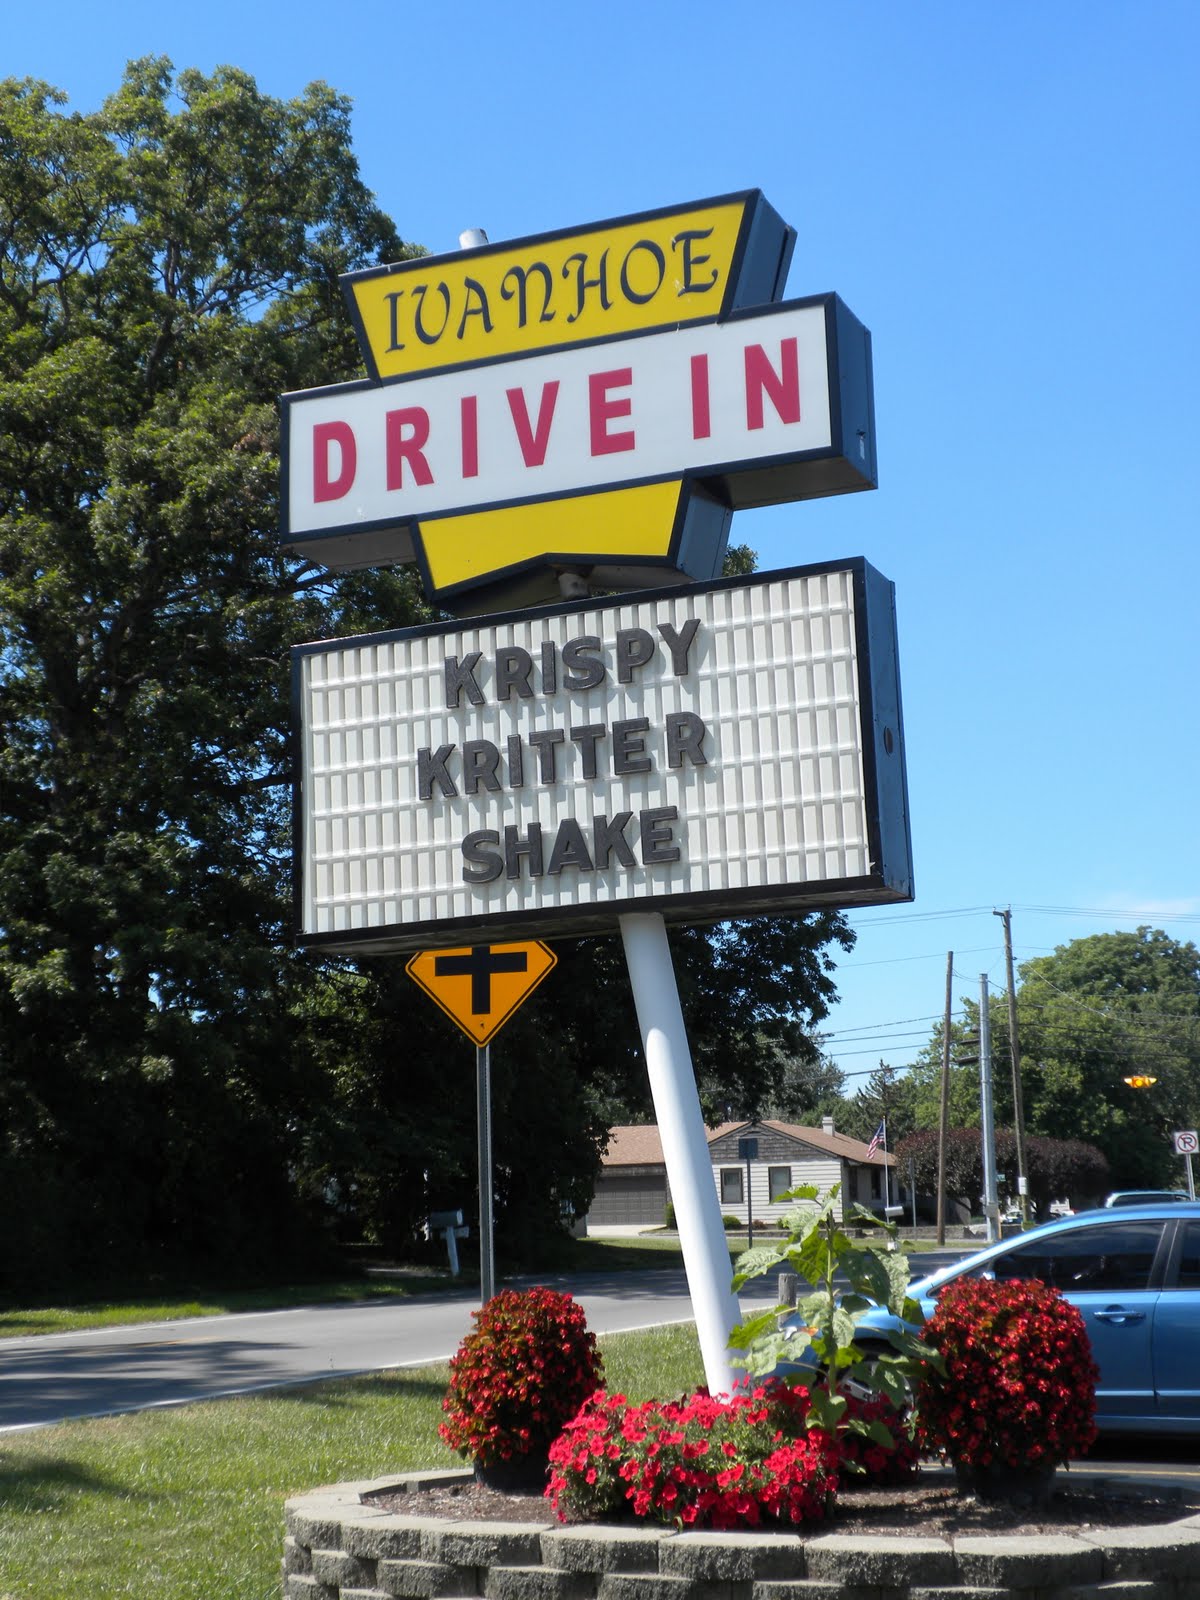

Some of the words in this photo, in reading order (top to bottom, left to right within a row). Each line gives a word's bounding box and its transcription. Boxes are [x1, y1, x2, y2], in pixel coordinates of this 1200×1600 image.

[382, 226, 720, 354] IVANHOE
[312, 366, 636, 503] DRIVE
[690, 337, 801, 440] IN
[444, 618, 701, 708] KRISPY
[417, 711, 708, 800] KRITTER
[462, 805, 681, 884] SHAKE
